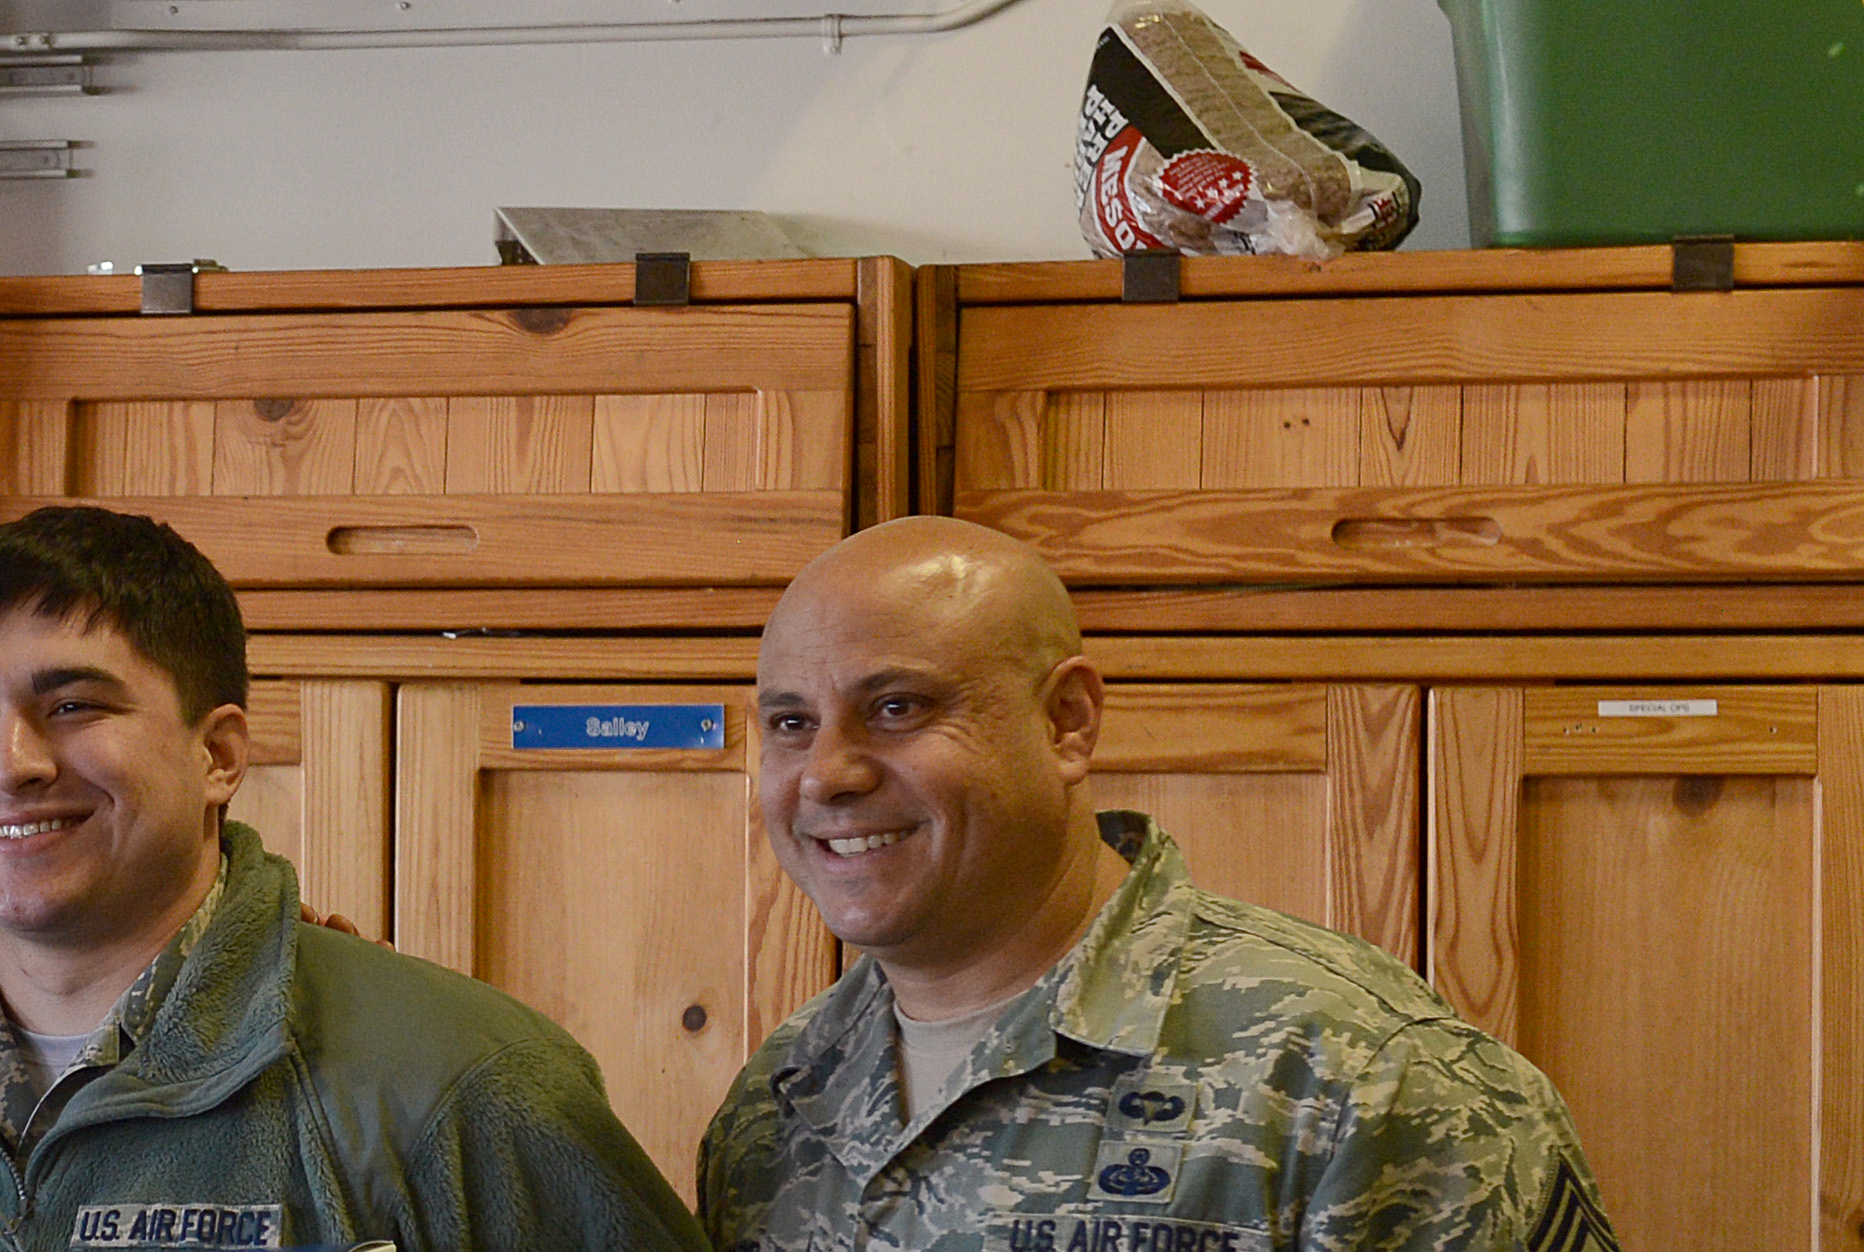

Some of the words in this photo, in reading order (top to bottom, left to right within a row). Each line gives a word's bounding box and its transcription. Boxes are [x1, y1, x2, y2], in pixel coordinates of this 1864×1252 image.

[78, 1209, 121, 1242] U.S.
[127, 1208, 177, 1242] AIR
[180, 1209, 272, 1246] FORCE
